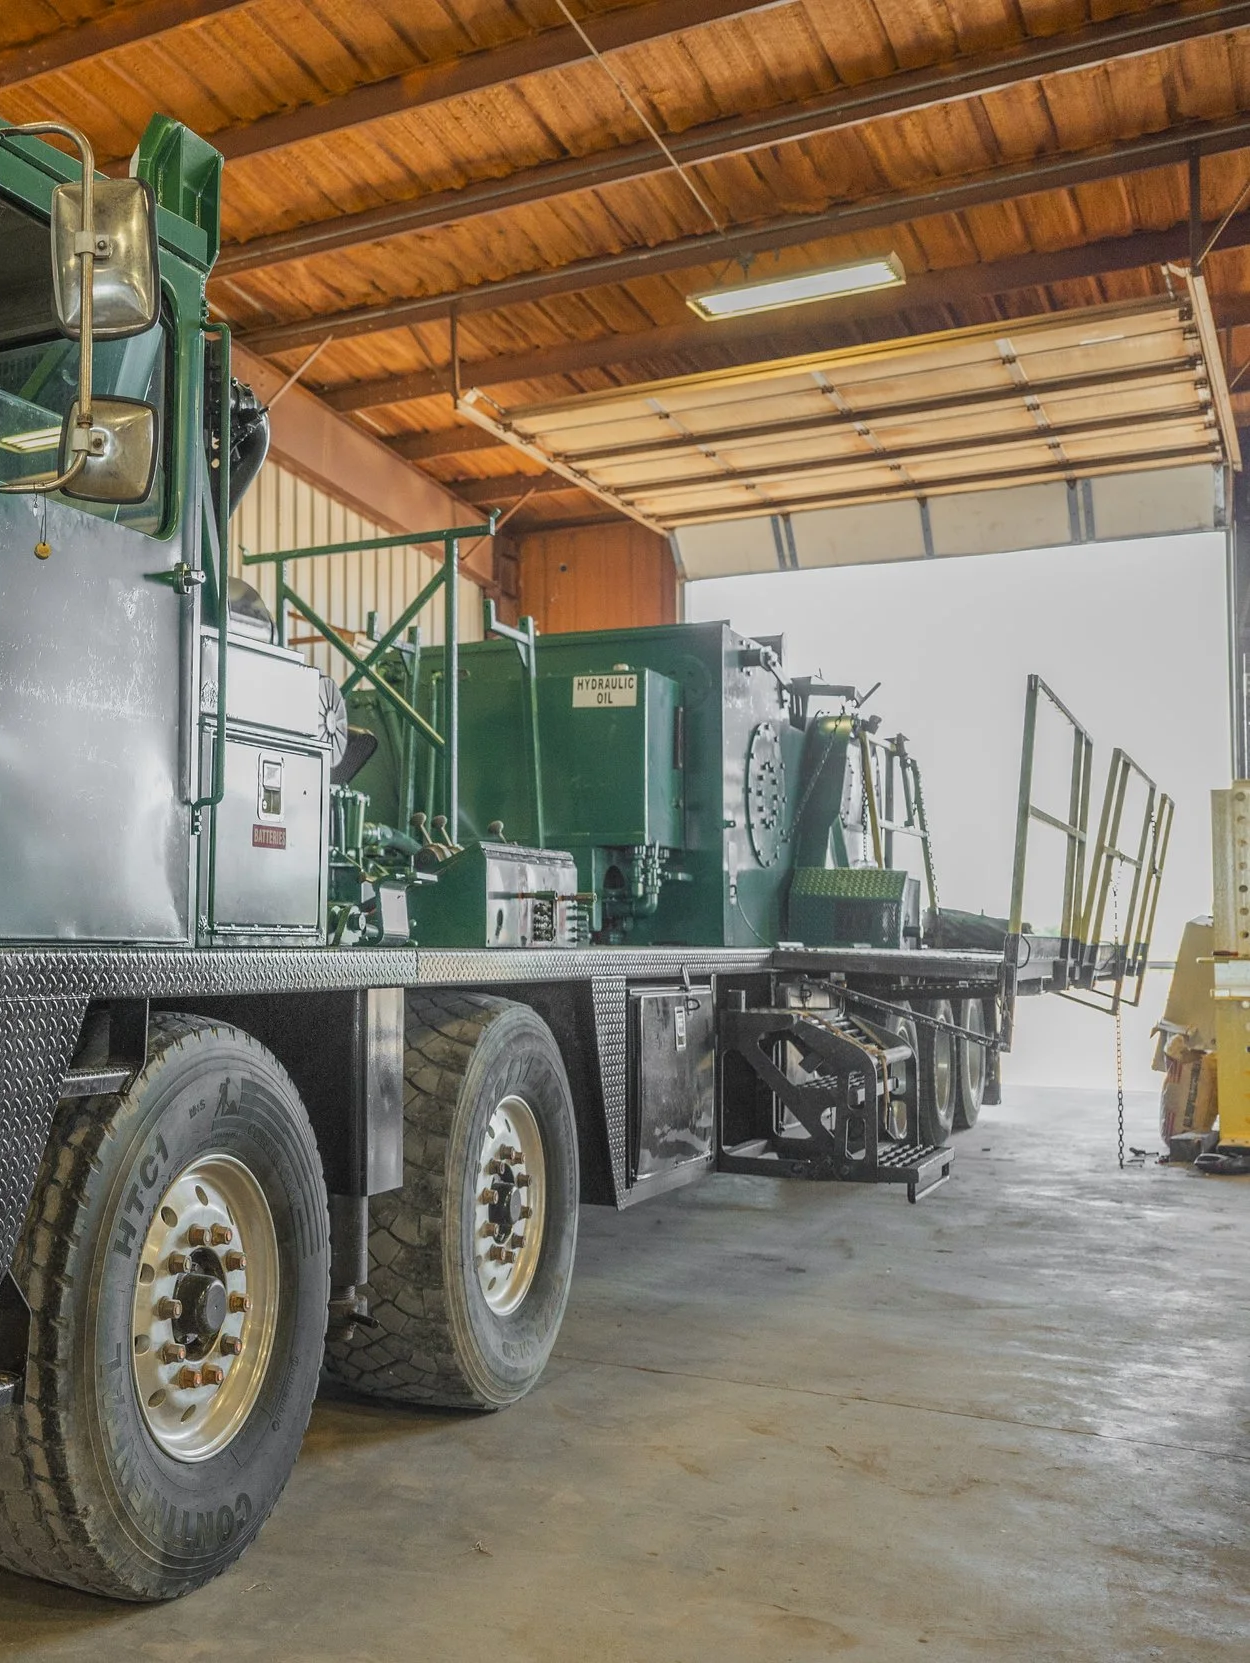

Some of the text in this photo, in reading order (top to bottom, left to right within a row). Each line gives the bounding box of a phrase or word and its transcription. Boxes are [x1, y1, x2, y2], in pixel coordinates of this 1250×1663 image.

[577, 677, 635, 692] HYDRAULIC
[597, 692, 614, 704] OIL
[254, 828, 286, 846] BATTERIES
[113, 1132, 170, 1260] HTC1
